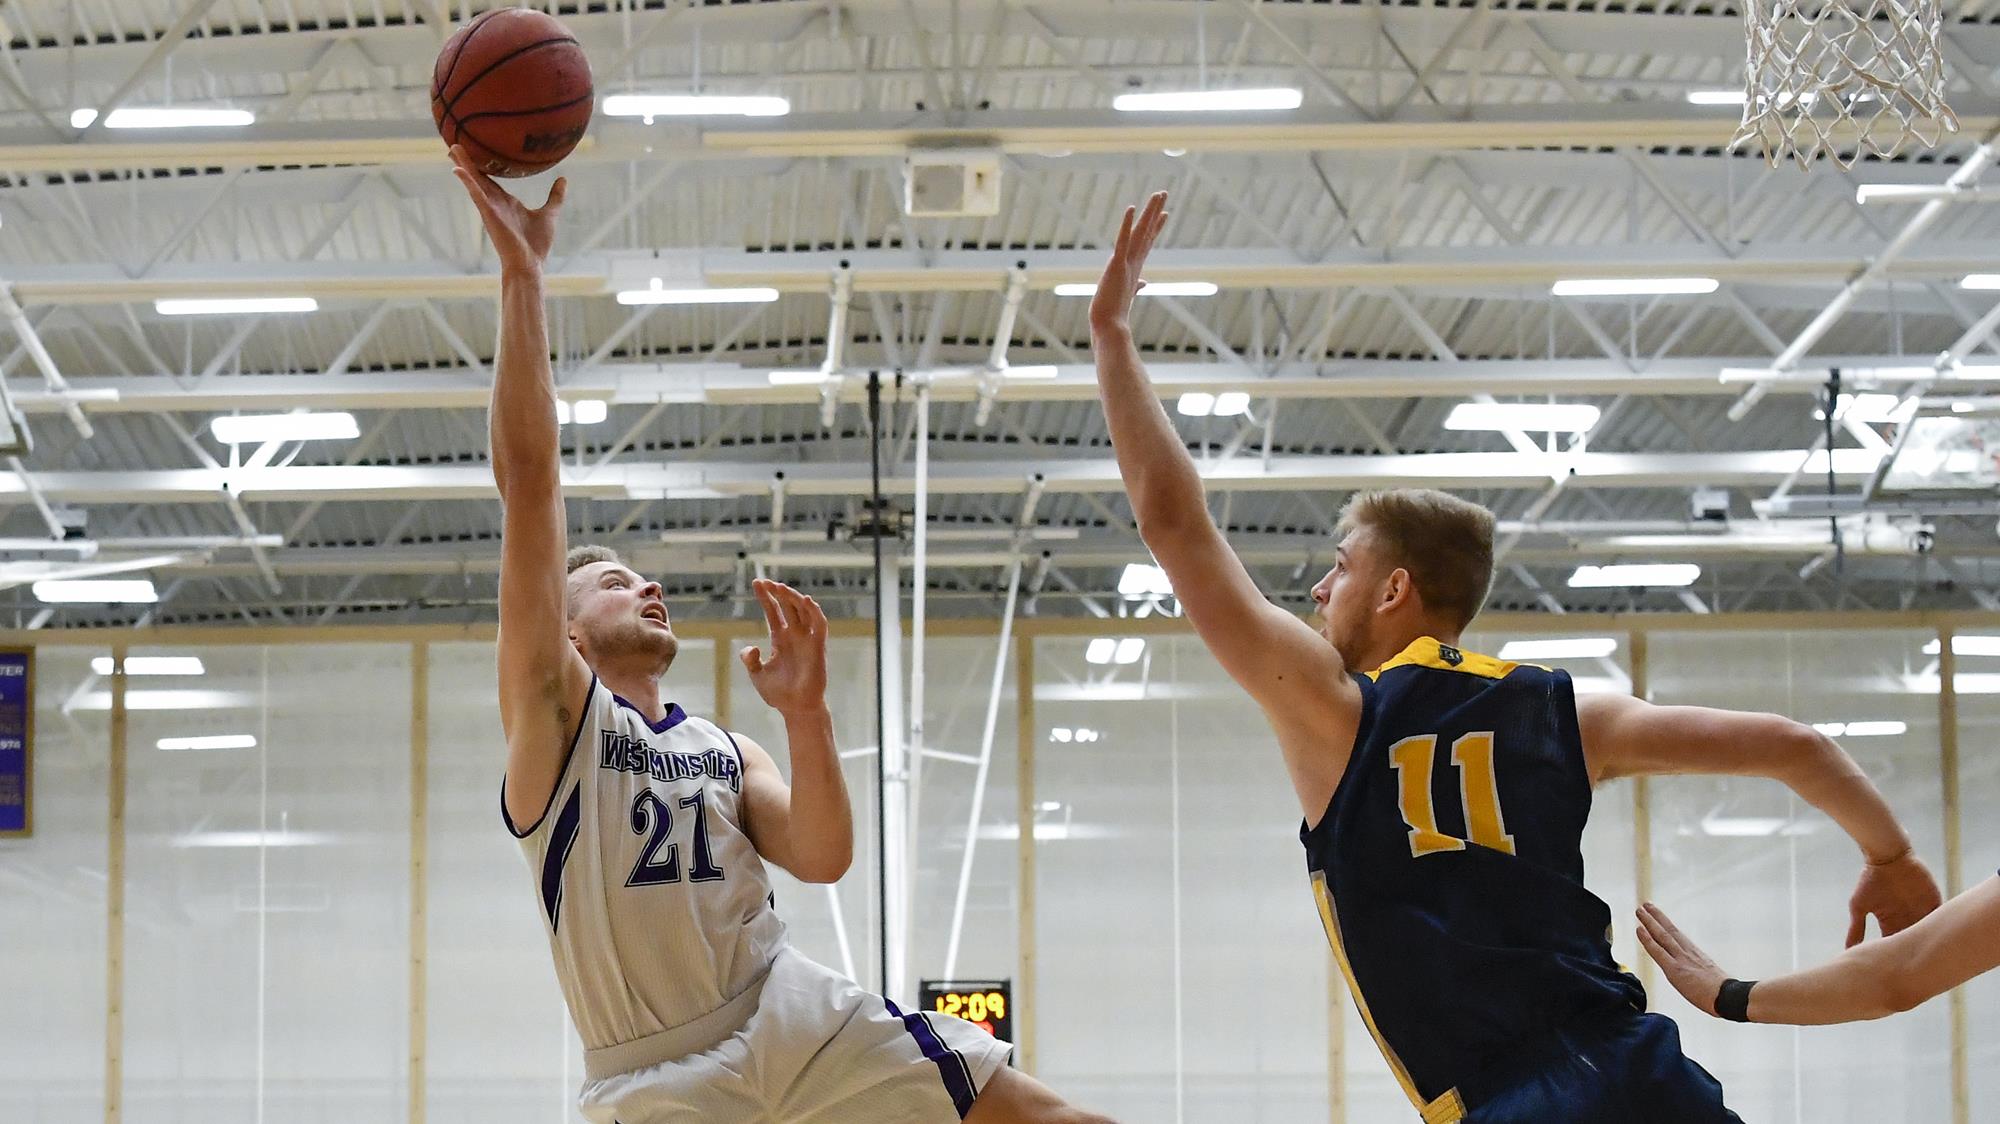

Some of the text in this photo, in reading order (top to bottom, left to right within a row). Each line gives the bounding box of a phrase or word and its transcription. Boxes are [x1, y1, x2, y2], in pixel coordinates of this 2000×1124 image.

[601, 729, 740, 793] WESTMINSTER
[1389, 731, 1516, 858] 11
[624, 787, 725, 887] 21
